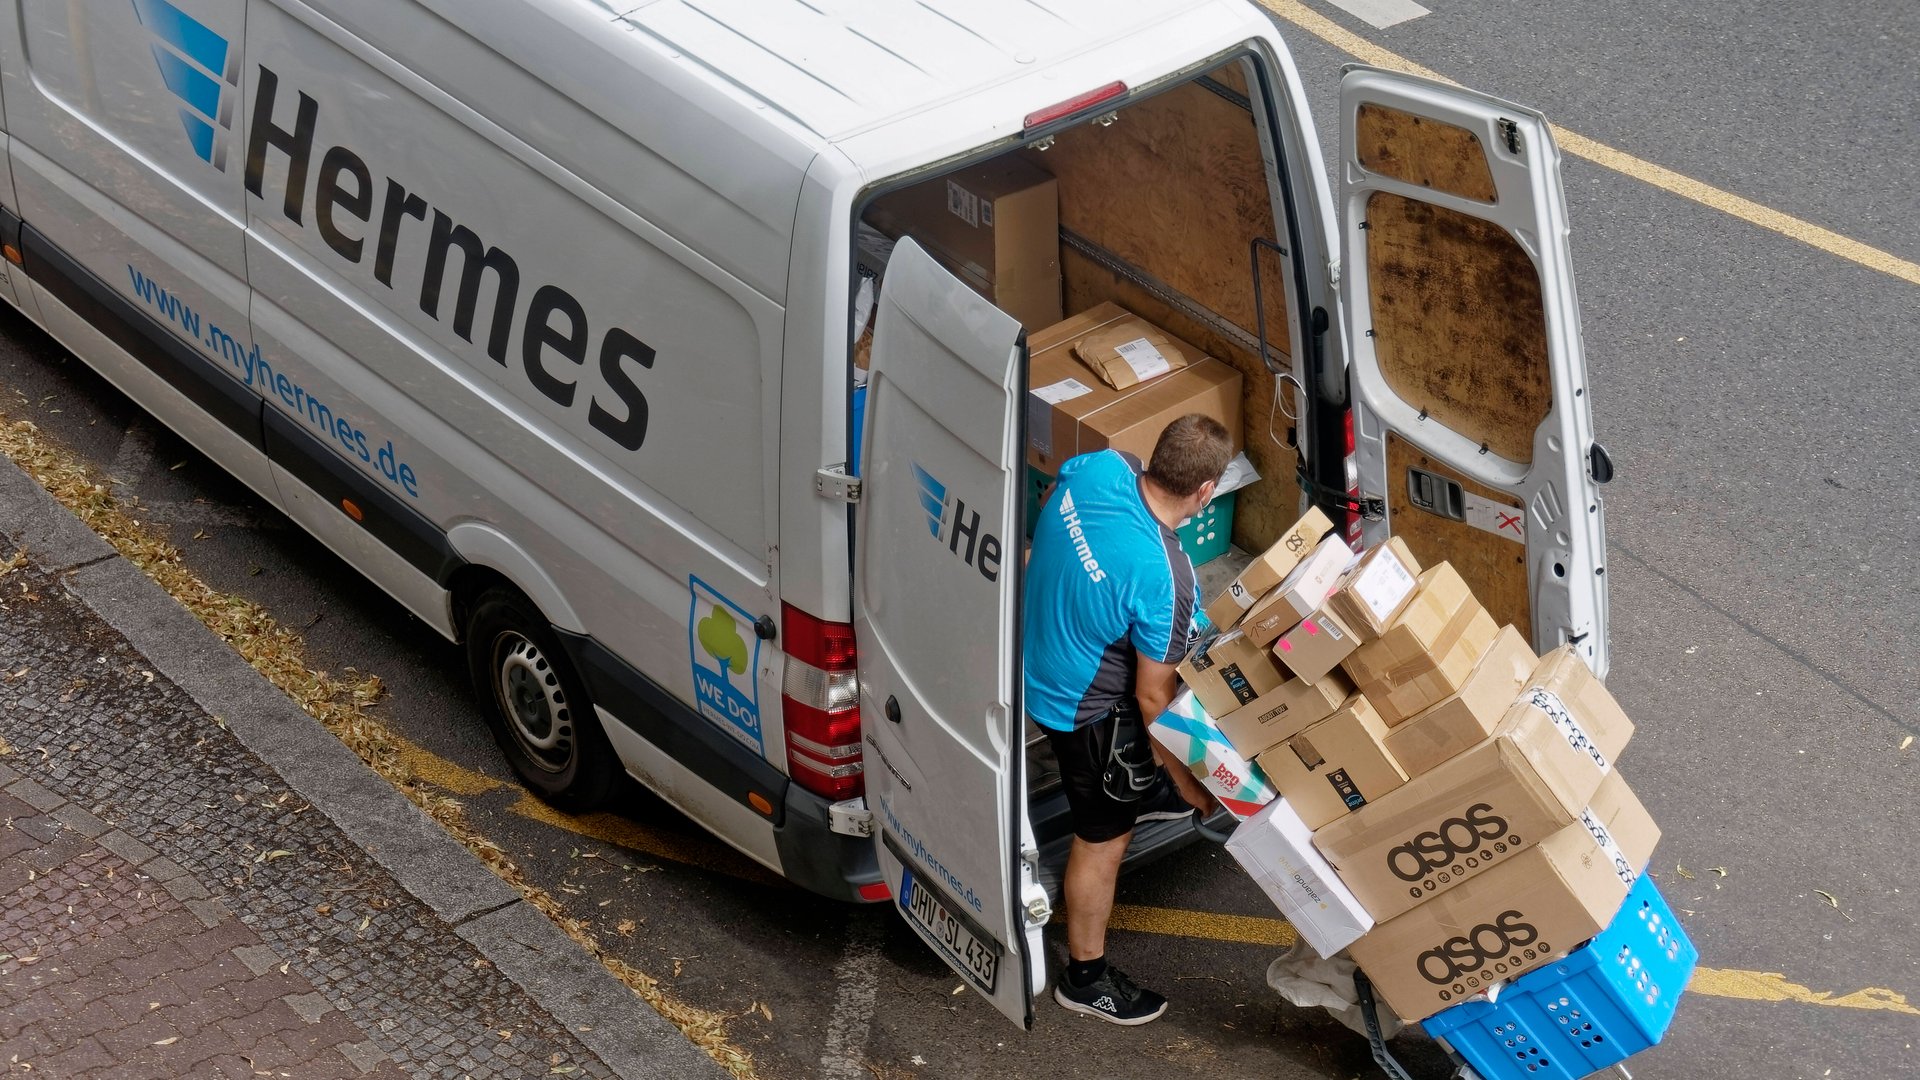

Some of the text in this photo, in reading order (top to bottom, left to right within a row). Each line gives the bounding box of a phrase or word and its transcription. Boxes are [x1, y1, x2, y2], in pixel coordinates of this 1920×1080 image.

[244, 63, 656, 452] Hermes
[127, 264, 419, 498] www.myhermes.de
[950, 498, 1002, 582] He
[1063, 511, 1107, 583] Hermes
[696, 673, 758, 733] WE DO!
[1212, 769, 1238, 789] prix
[1217, 763, 1240, 784] bon
[879, 794, 982, 912] www.myhermes.de
[1387, 803, 1508, 882] asos
[911, 882, 937, 927] OHV
[944, 916, 962, 955] SL
[965, 937, 993, 980] 433
[1416, 910, 1538, 985] asos
